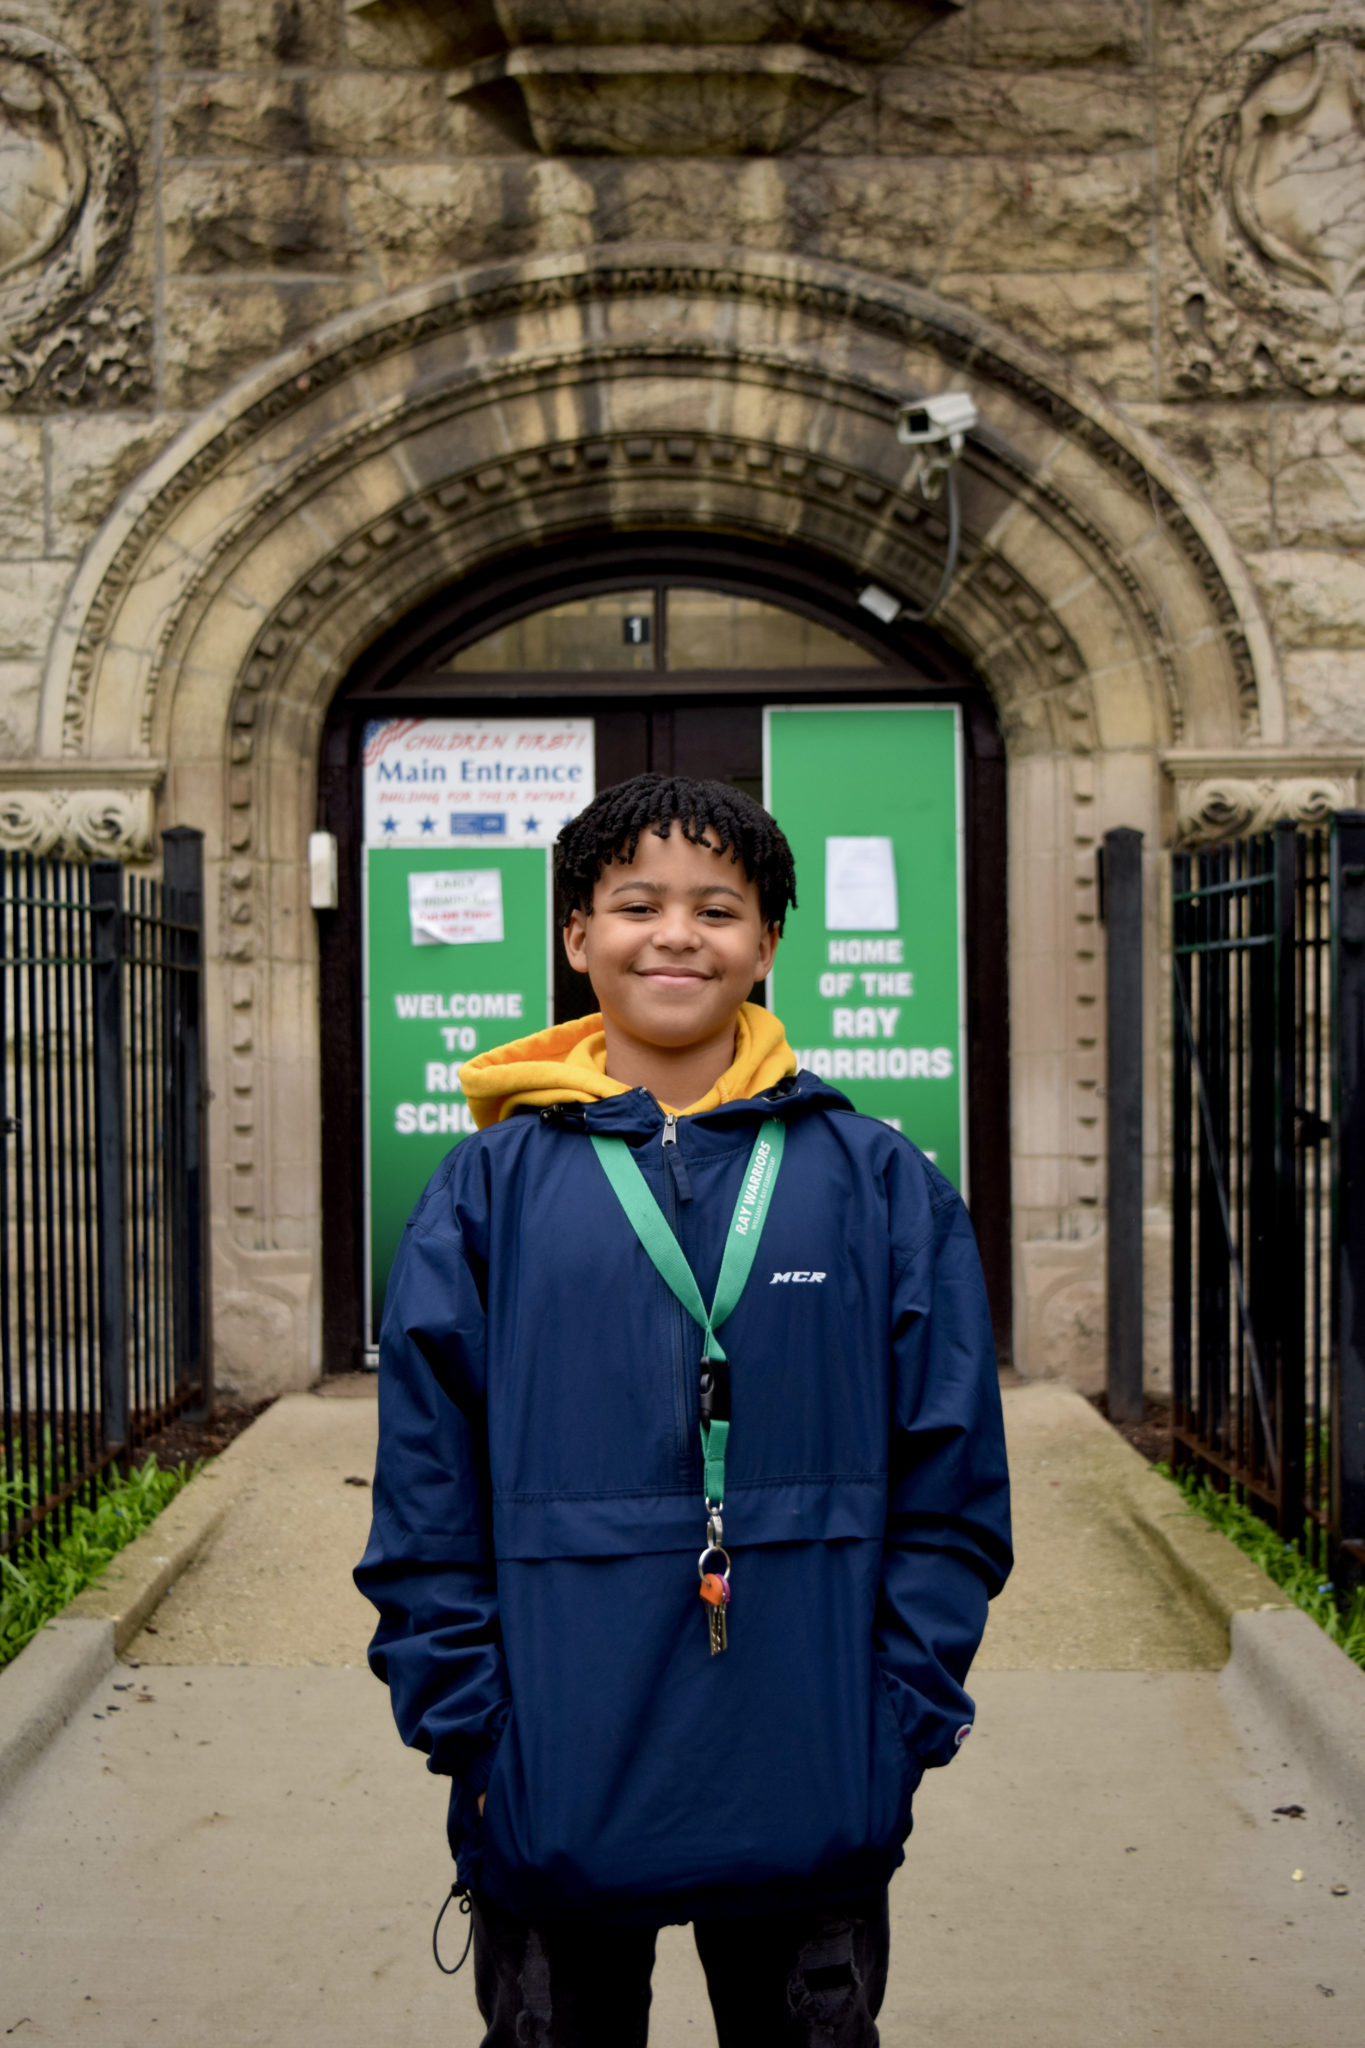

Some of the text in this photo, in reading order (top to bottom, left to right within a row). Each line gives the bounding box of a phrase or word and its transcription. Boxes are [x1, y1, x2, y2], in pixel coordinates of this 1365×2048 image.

[629, 618, 641, 643] 1
[404, 733, 508, 751] CHILDREN
[377, 758, 582, 782] Main Entrance
[828, 939, 903, 964] HOME
[819, 972, 914, 997] OF THE
[394, 993, 522, 1019] WELCOME
[832, 1007, 900, 1039] RAY
[441, 1026, 476, 1052] TO
[426, 1061, 464, 1093] RA
[395, 1102, 480, 1135] SCHO
[735, 1140, 771, 1236] RAY WARRIORS
[769, 1271, 827, 1284] MCR
